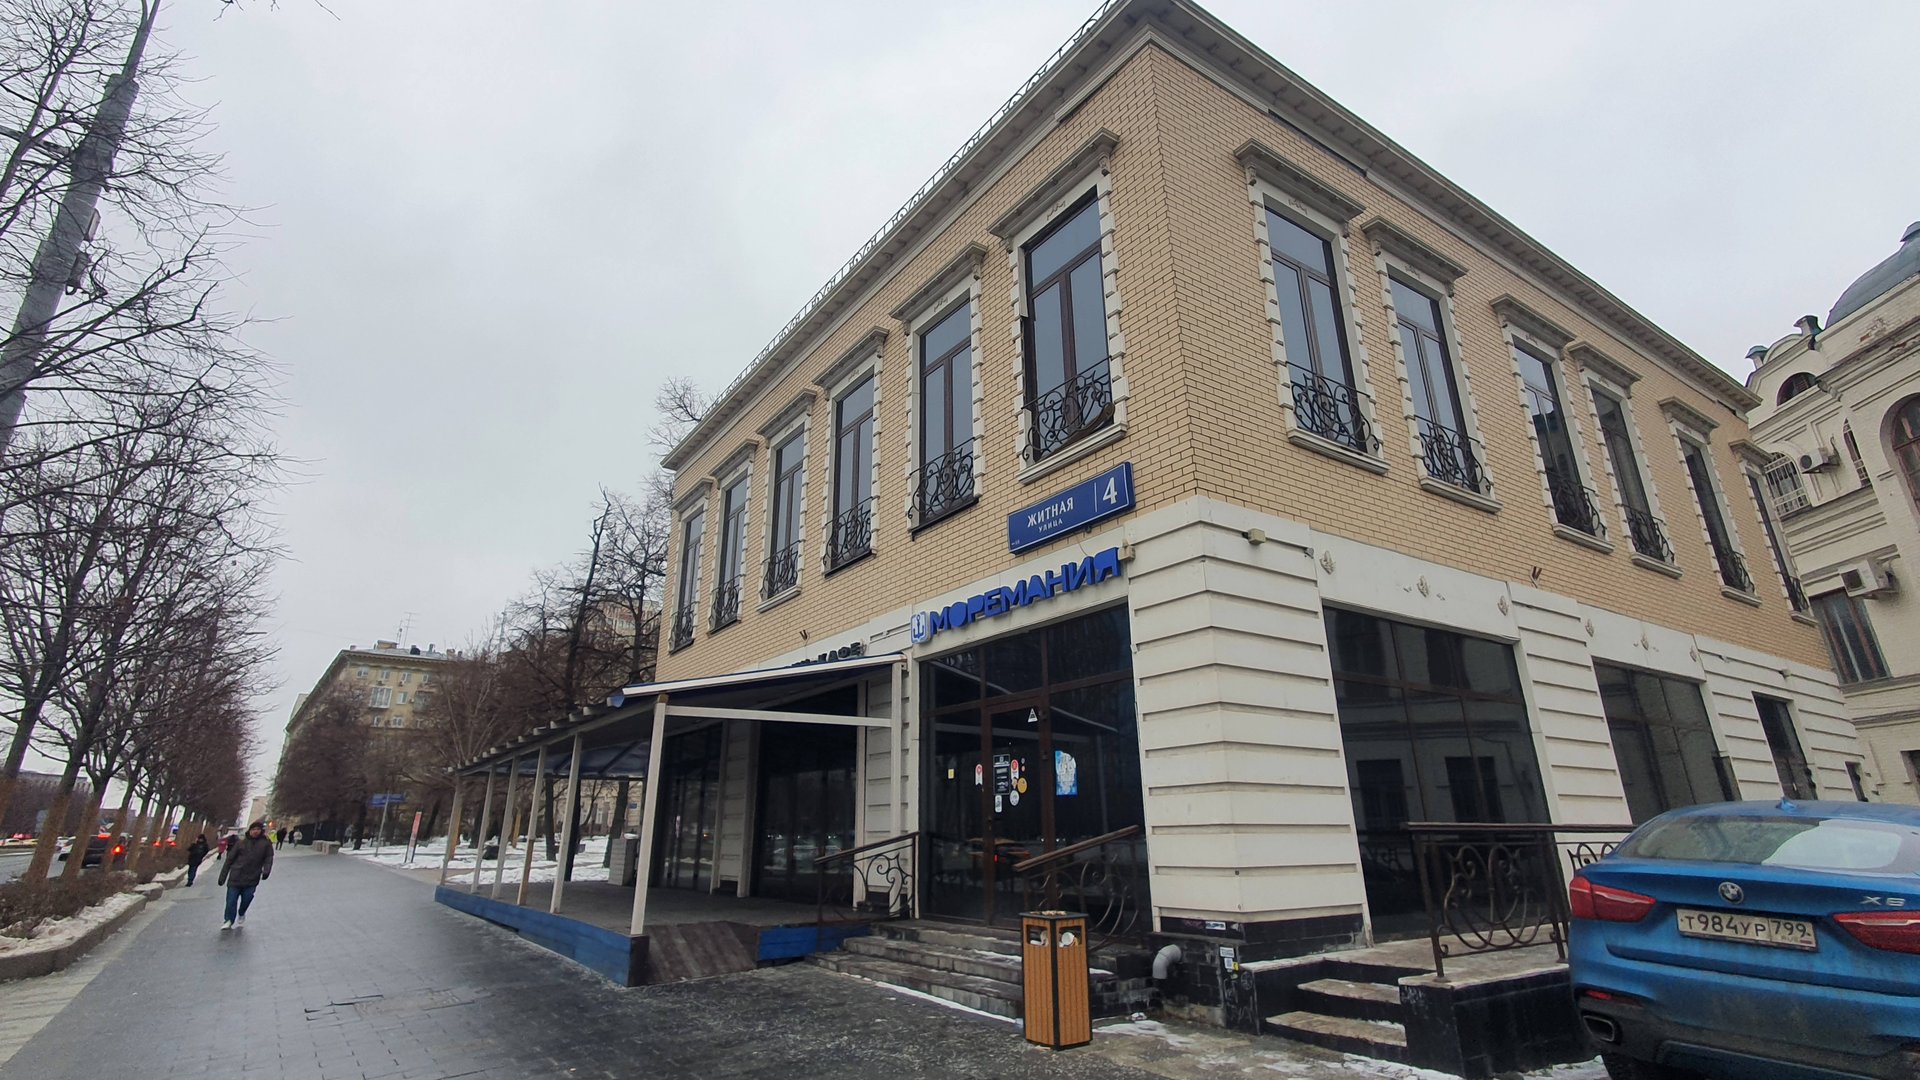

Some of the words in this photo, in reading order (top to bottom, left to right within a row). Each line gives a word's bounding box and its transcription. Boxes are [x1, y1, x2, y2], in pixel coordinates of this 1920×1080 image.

[1027, 497, 1074, 528] ЖИТНАЯ
[1102, 477, 1118, 505] 4
[1038, 518, 1063, 533] УЛИЦА
[930, 547, 1121, 636] МОРЕМАНИЯ
[1860, 896, 1905, 907] X6
